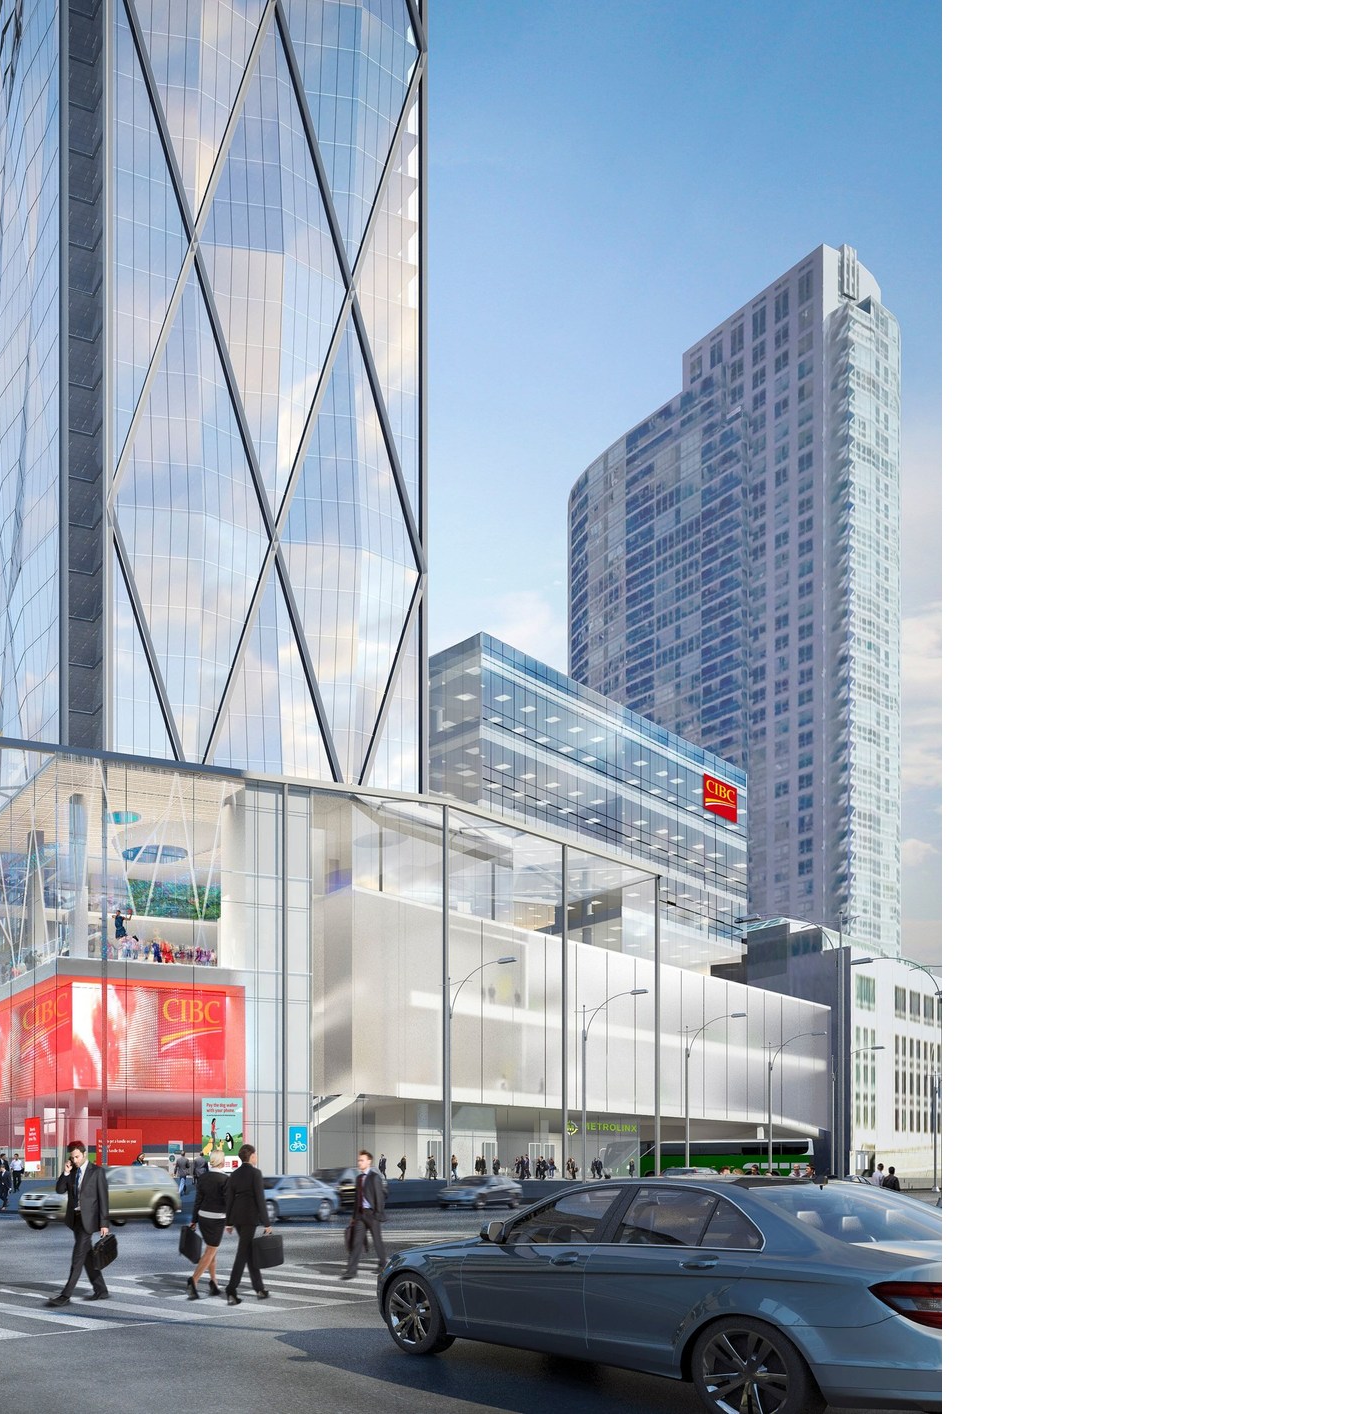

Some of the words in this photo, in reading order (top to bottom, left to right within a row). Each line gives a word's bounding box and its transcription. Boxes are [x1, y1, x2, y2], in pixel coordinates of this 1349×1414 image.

[706, 779, 735, 804] CIBC
[23, 993, 68, 1031] CIBC
[162, 998, 220, 1024] CIBC
